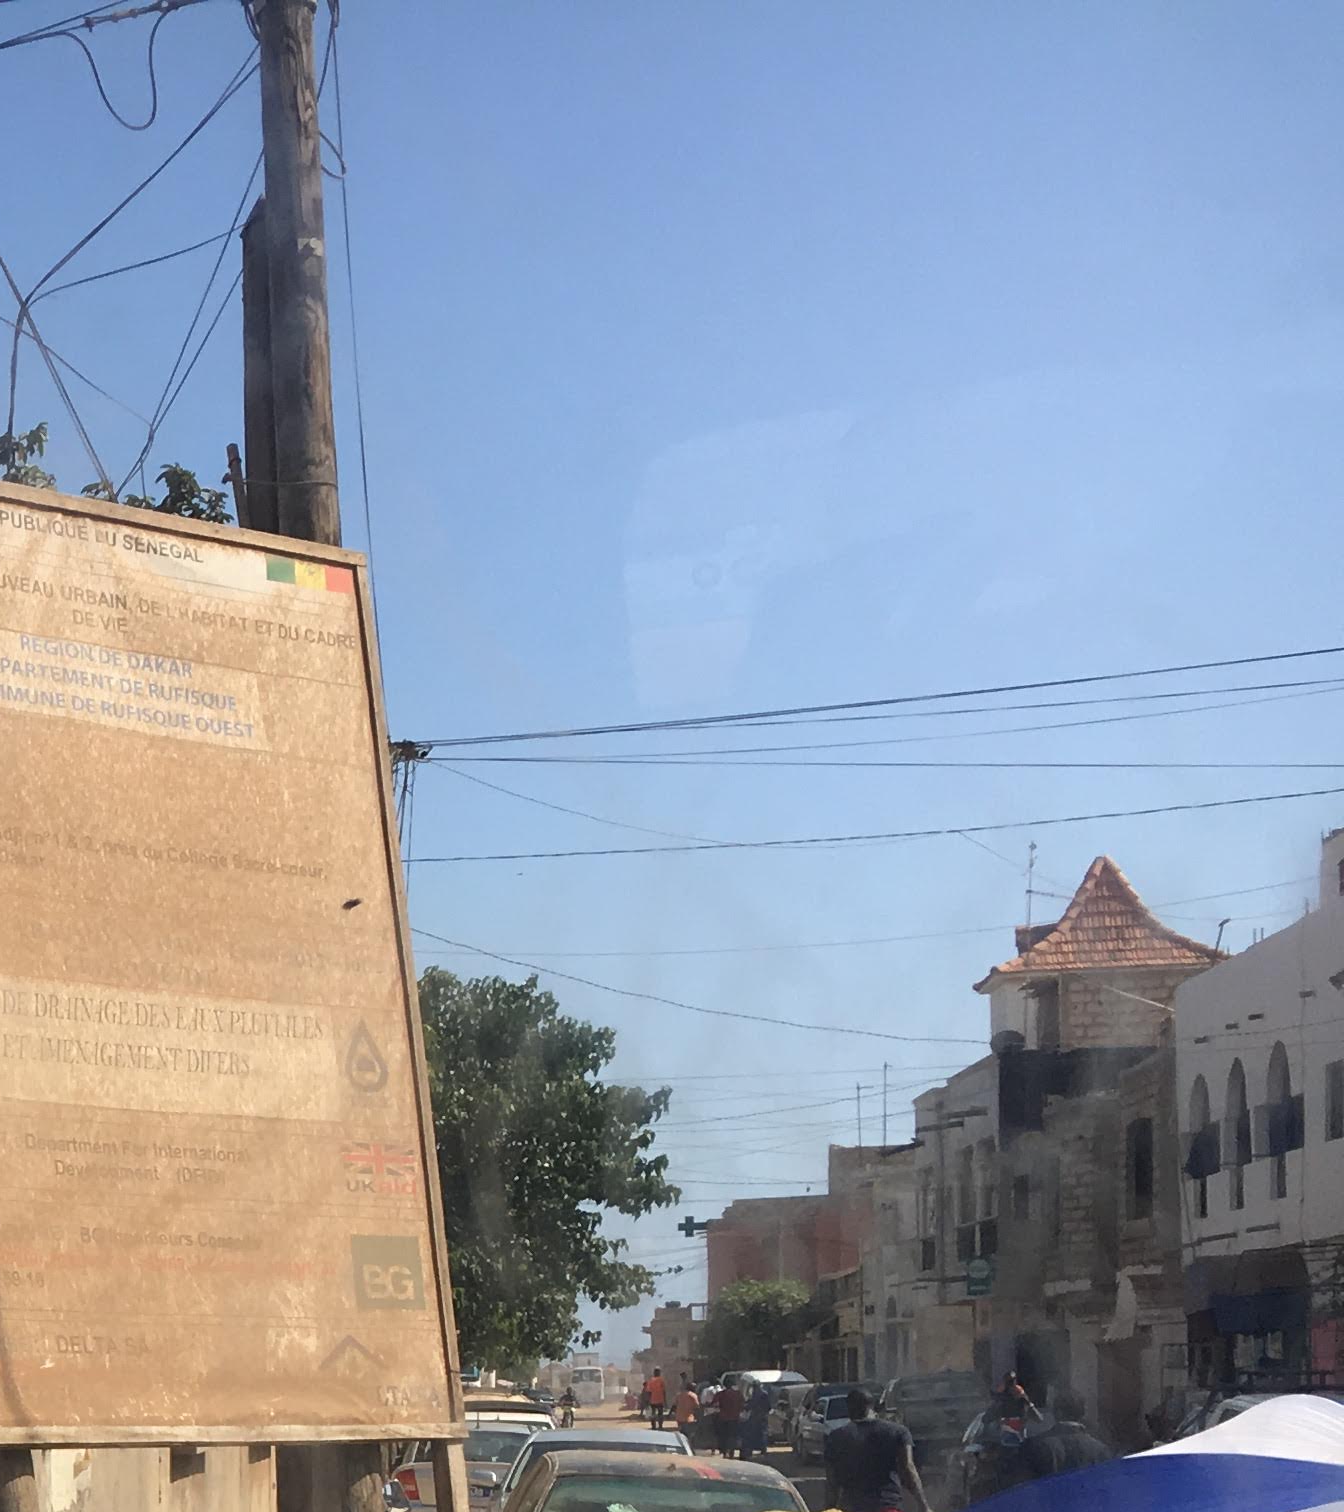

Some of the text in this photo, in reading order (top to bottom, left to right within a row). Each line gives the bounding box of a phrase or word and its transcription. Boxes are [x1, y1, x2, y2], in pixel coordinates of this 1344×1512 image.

[122, 534, 204, 565] SENEGAL
[59, 584, 133, 612] URBAIN,
[139, 597, 163, 618] DE
[254, 618, 275, 638] ET
[278, 622, 301, 642] DU
[303, 627, 359, 651] CADRE
[72, 608, 129, 633] DE VIE
[19, 633, 193, 679] REGION DE DAKAR
[119, 677, 144, 696] DE
[148, 683, 238, 712] RUFISQUE
[71, 694, 96, 714] DE
[100, 700, 192, 731] RUFISQUE
[195, 714, 255, 740] OUEST
[1, 987, 30, 1018] DE
[33, 991, 132, 1027] DRAINAGE
[135, 1002, 171, 1030] DES
[175, 1005, 225, 1034] EAUX
[362, 1263, 417, 1303] BG
